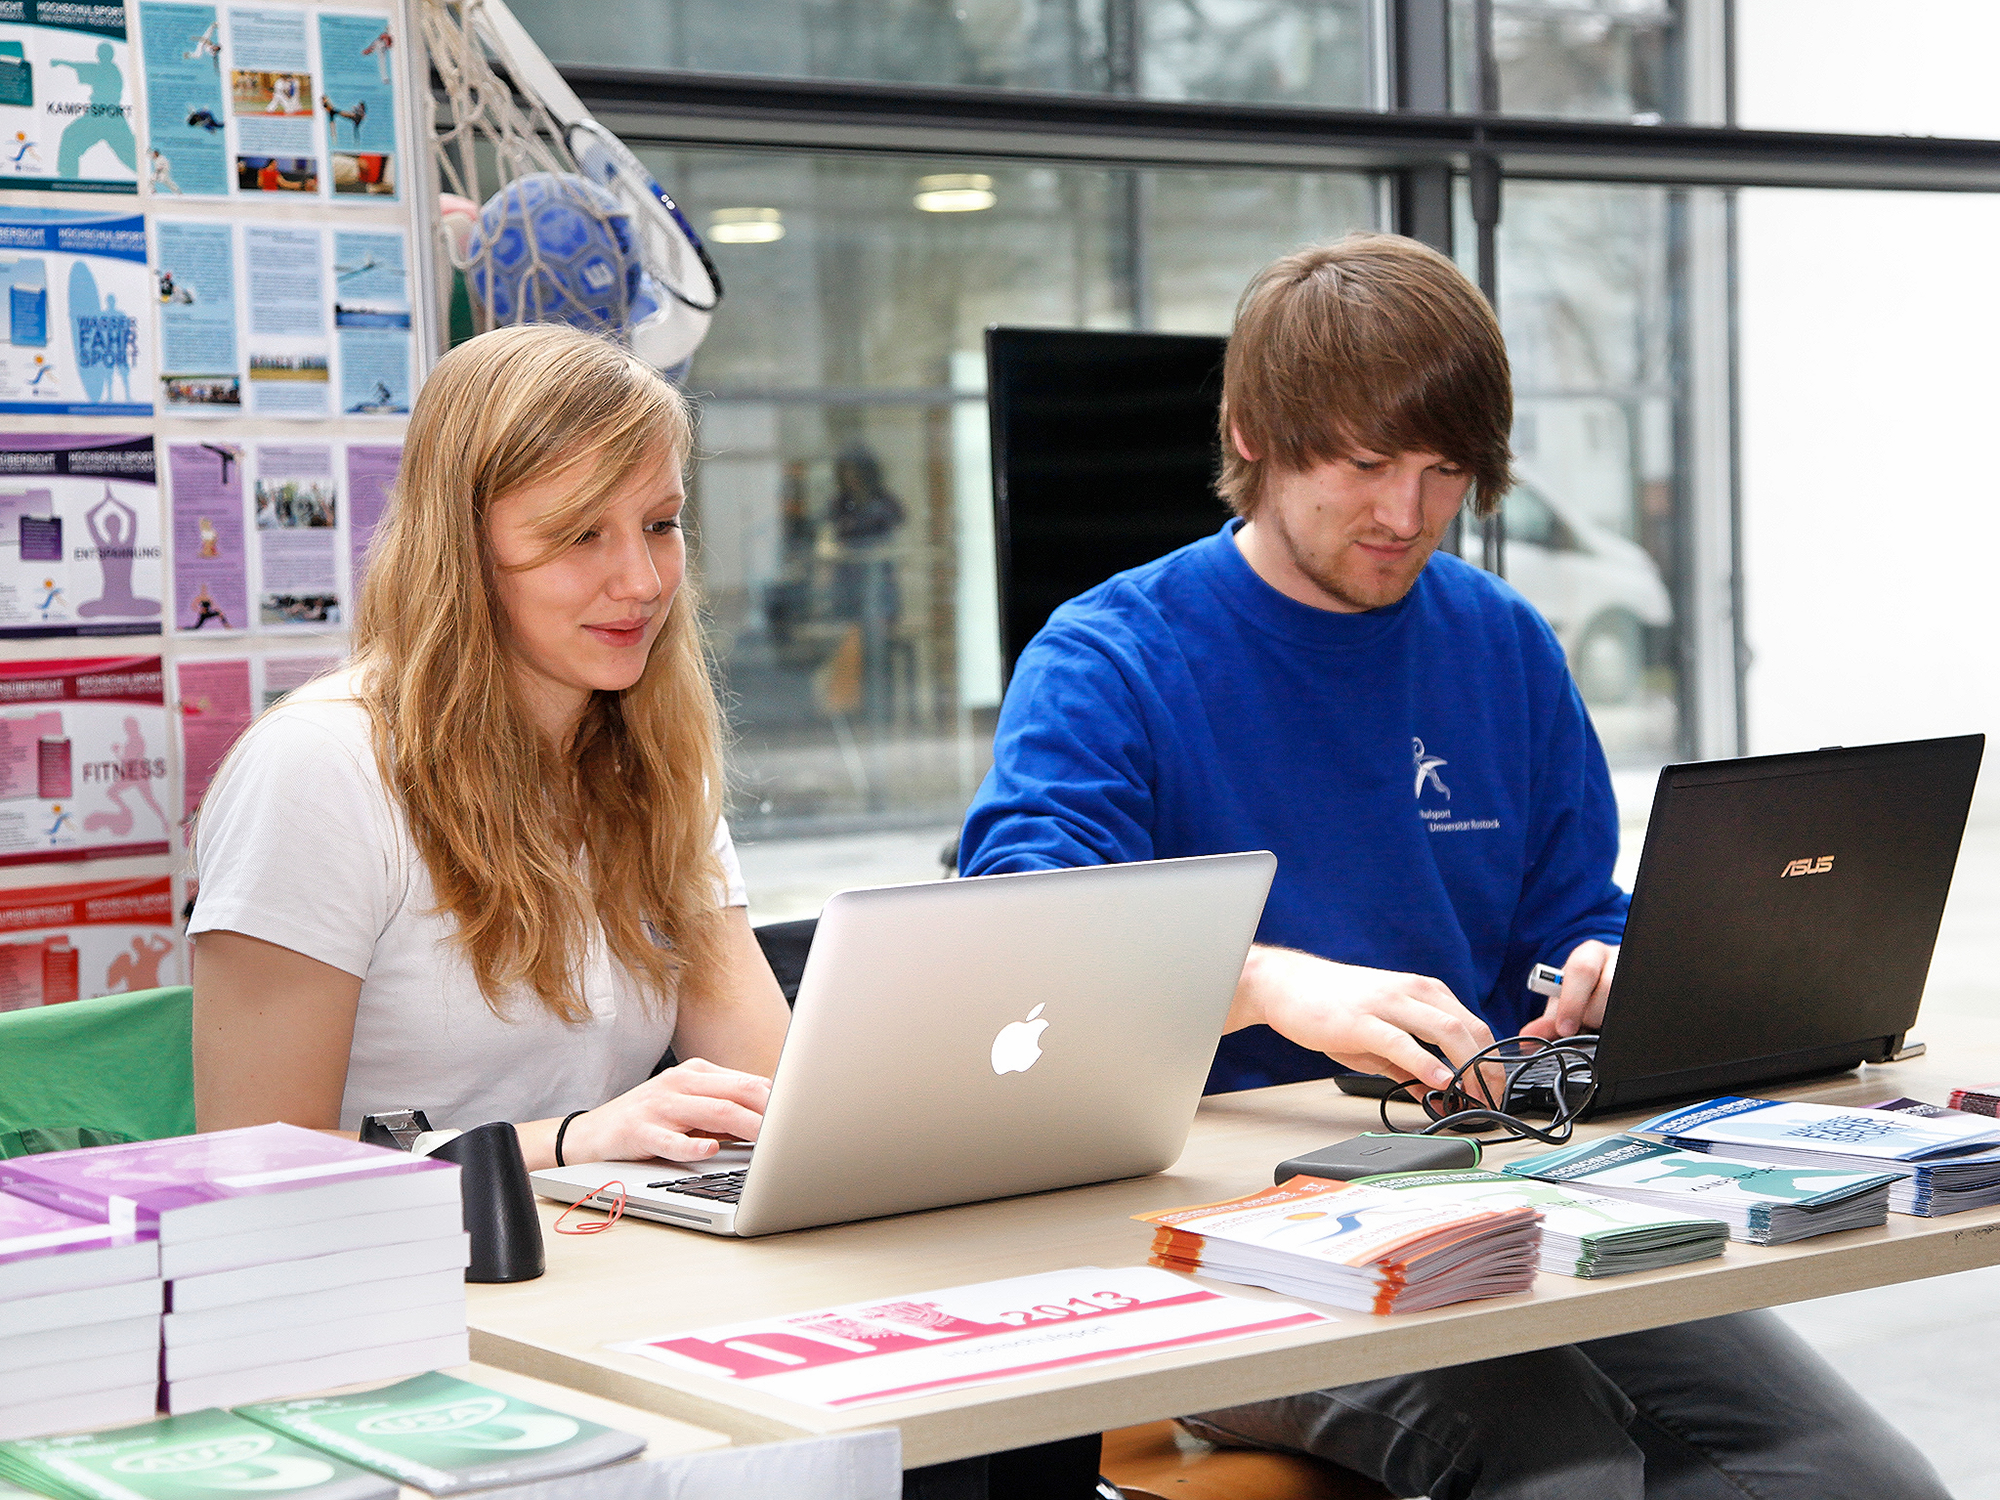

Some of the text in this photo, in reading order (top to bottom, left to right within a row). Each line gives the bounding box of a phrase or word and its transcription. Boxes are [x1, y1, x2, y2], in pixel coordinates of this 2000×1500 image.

[46, 101, 132, 118] KAMPFSPORT
[79, 329, 137, 351] FAHR
[79, 349, 138, 369] SPORT
[73, 545, 162, 561] ENTSPANNUNG
[82, 758, 167, 783] FITNESS
[1780, 855, 1835, 878] ASUS
[999, 1291, 1140, 1327] 2013
[376, 1406, 487, 1431] USA
